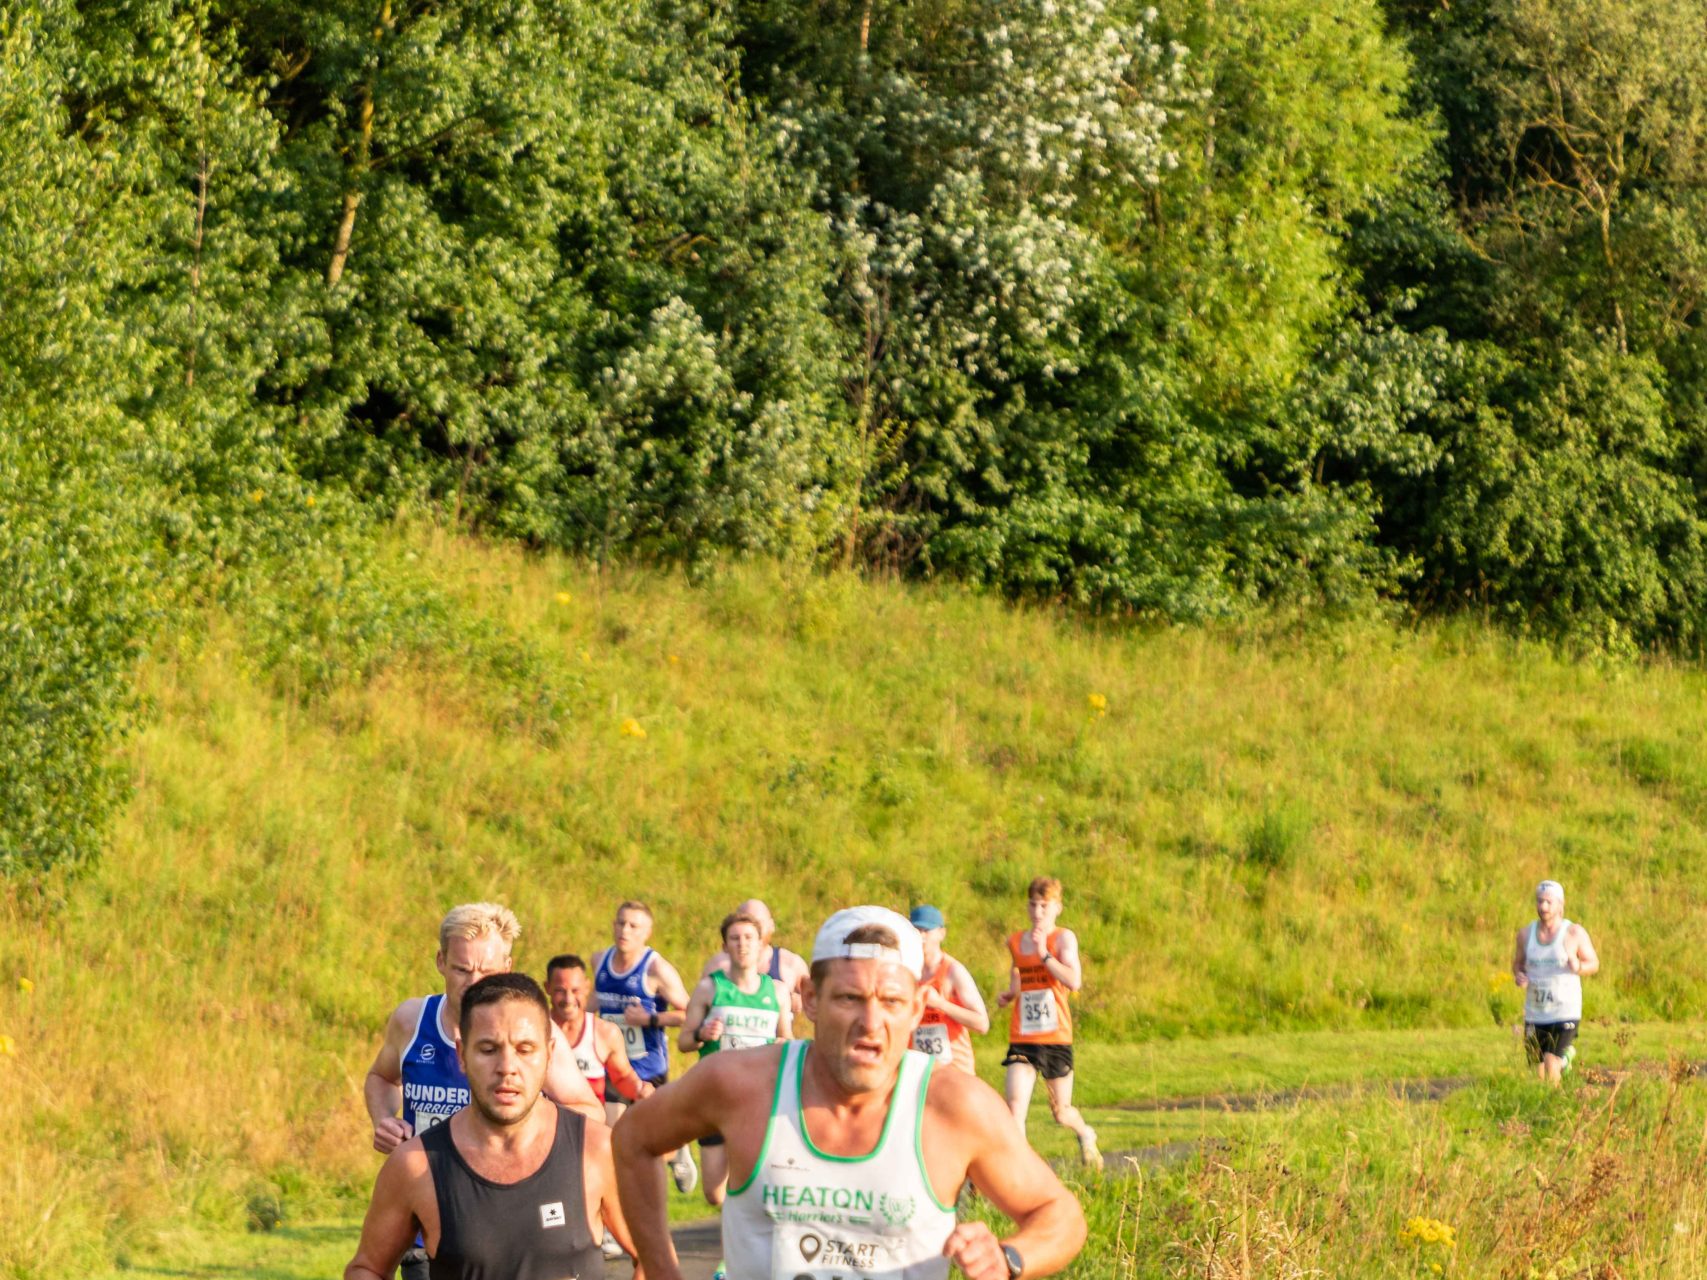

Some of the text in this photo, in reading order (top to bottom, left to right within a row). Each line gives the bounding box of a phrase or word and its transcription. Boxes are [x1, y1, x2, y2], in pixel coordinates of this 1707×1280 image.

[1025, 1003, 1050, 1021] 354
[725, 1013, 769, 1030] BLYTH
[410, 1100, 466, 1114] HARRIER
[762, 1183, 874, 1211] HEATON
[825, 1240, 879, 1257] START
[822, 1254, 875, 1268] FITNESS
